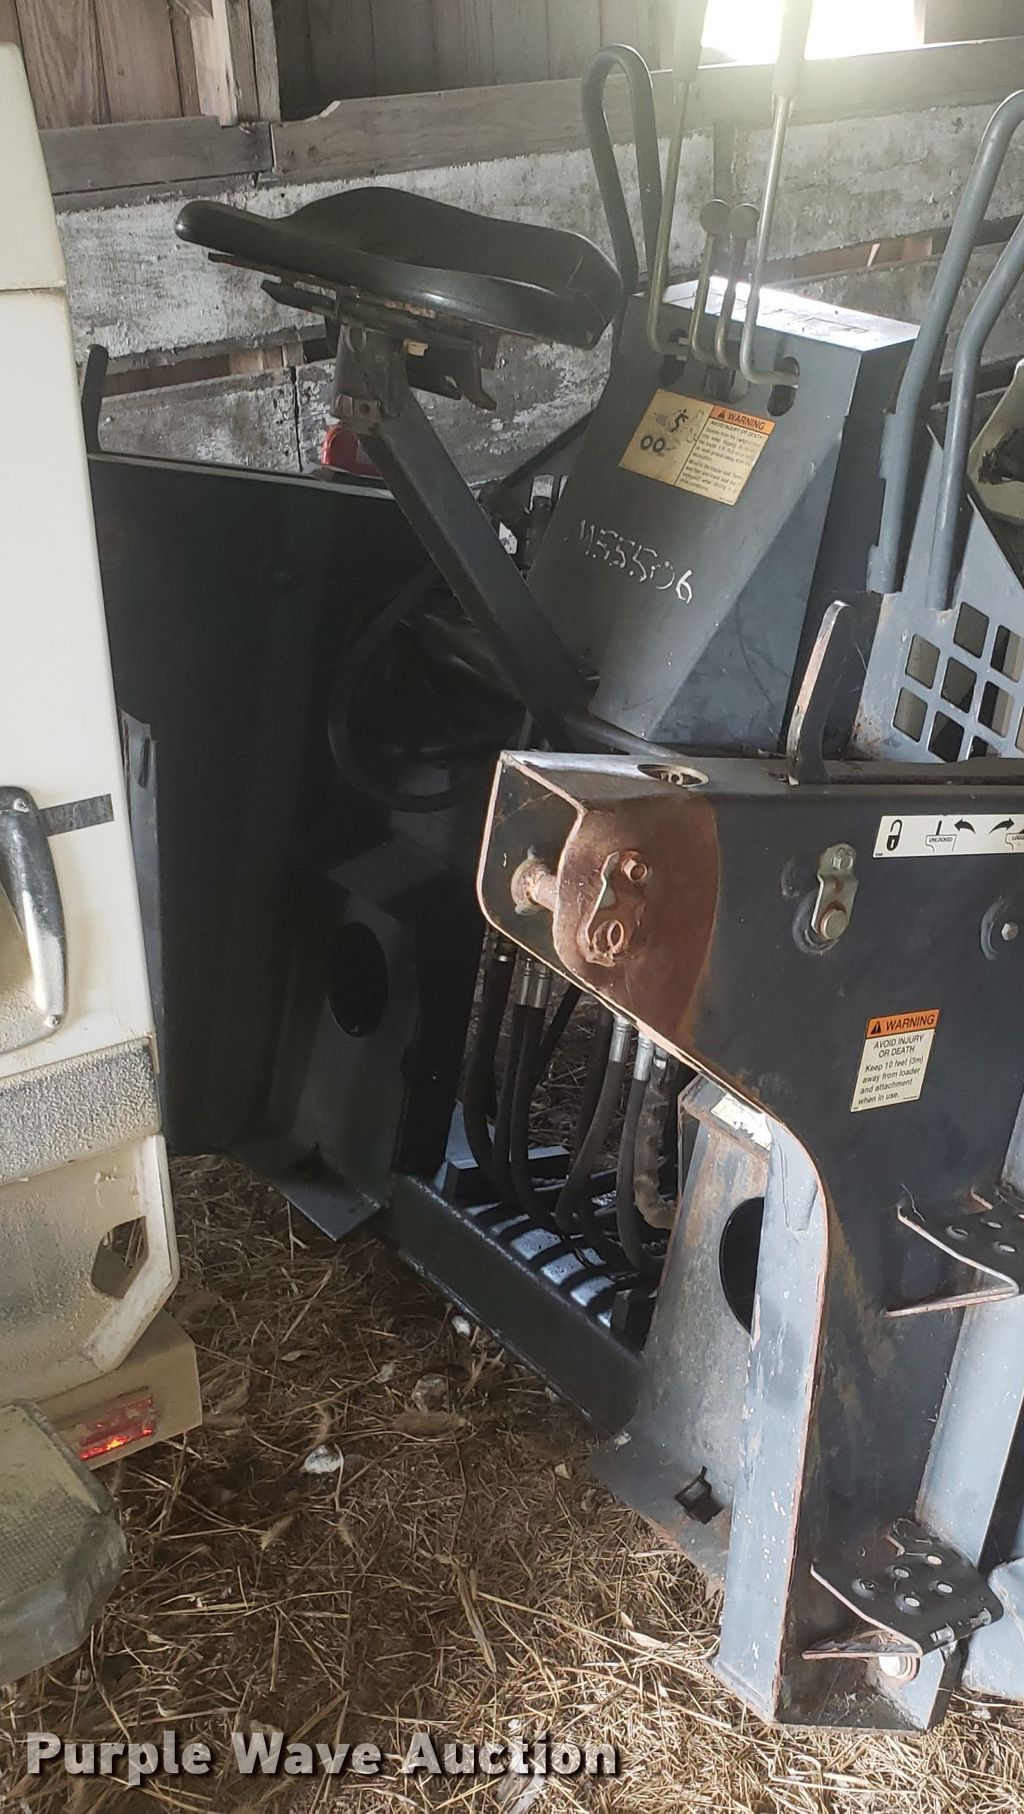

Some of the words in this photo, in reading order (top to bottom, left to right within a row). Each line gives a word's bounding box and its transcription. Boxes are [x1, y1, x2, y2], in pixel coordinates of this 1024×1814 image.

[728, 412, 765, 430] WARNING
[886, 1014, 935, 1032] WARNING
[874, 1038, 896, 1049] AVOID
[898, 1034, 924, 1046] INJURY
[879, 1049, 890, 1058] OR
[891, 1045, 915, 1056] DEATH
[865, 1063, 882, 1072] Keep
[885, 1061, 893, 1069] 10
[895, 1059, 908, 1068] feet
[909, 1055, 924, 1066] (3m)
[862, 1074, 881, 1083] away
[882, 1071, 898, 1080] from
[899, 1067, 921, 1076] loader
[860, 1085, 873, 1095] and
[875, 1078, 913, 1092] attachment
[858, 1095, 877, 1105] when
[885, 1091, 899, 1100] use.
